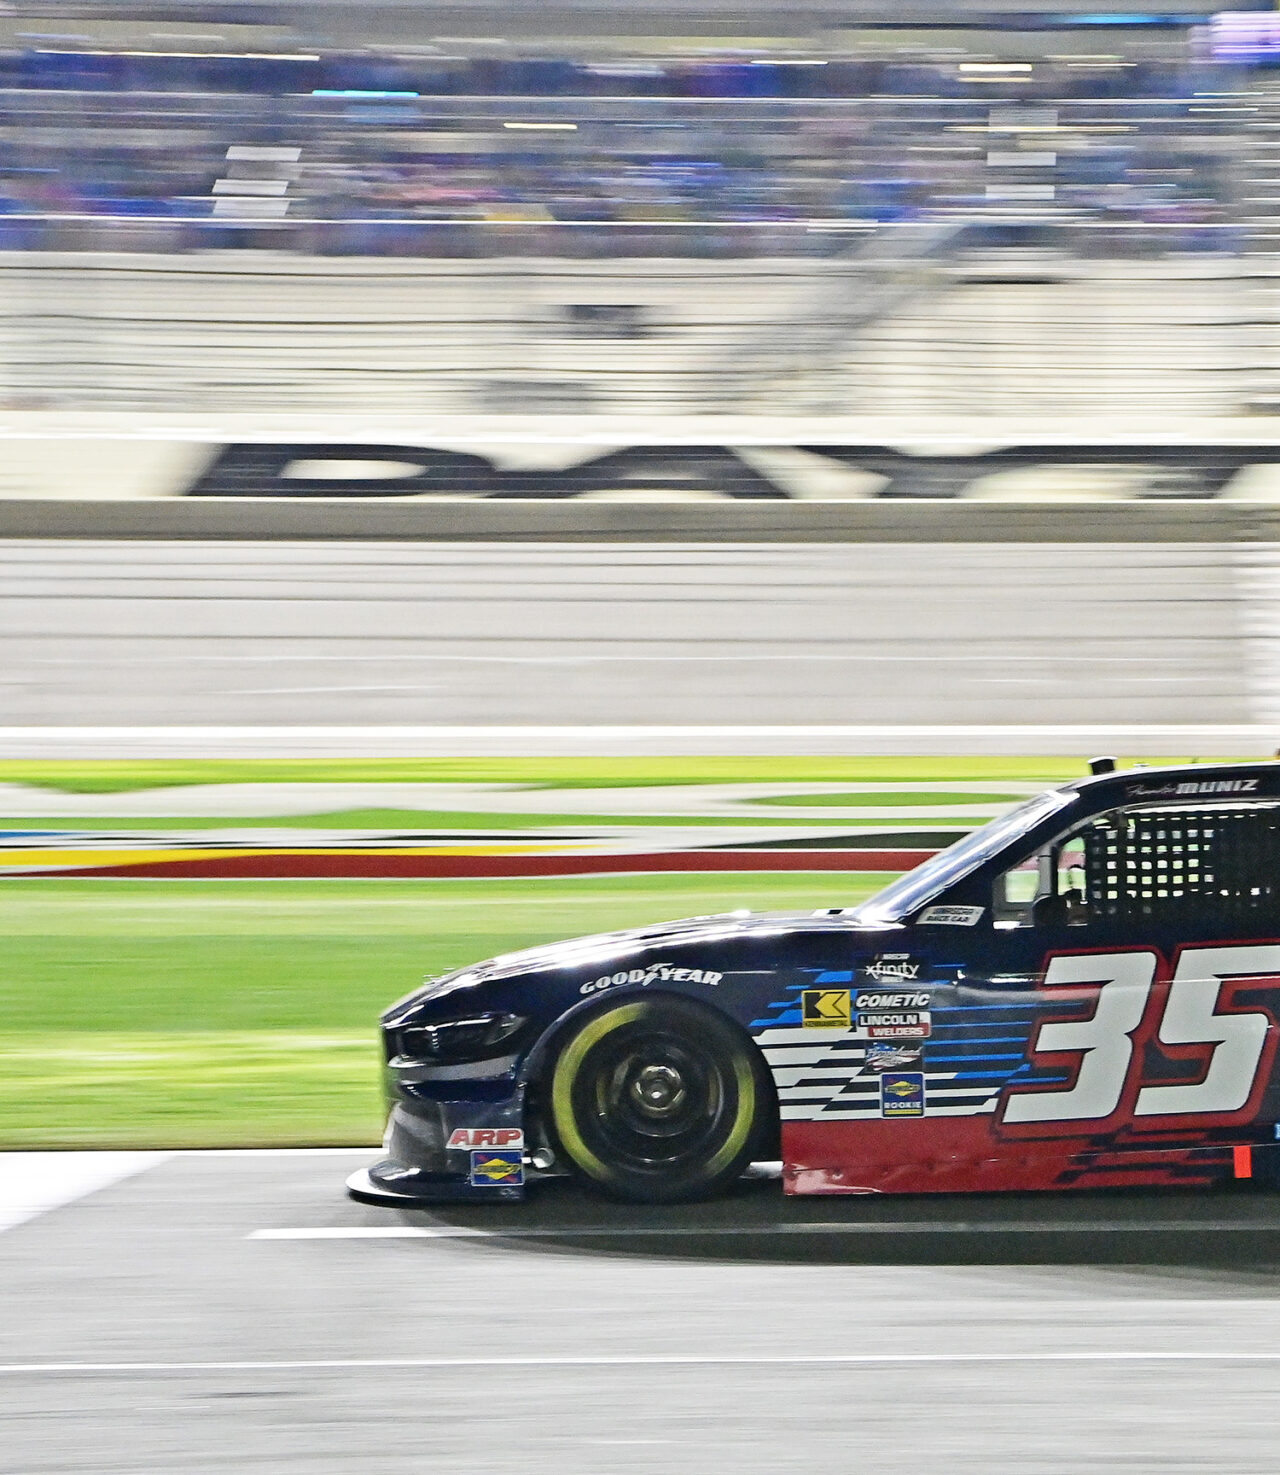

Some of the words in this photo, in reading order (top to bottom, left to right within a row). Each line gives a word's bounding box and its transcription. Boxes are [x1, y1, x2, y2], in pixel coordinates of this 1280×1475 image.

[1176, 779, 1259, 794] MUNIZ
[865, 961, 920, 979] xfinity
[579, 962, 724, 995] GOODYEAR
[855, 991, 931, 1009] COMETIC
[860, 1014, 918, 1026] LINCOLN
[872, 1027, 925, 1037] WELDERS
[883, 1101, 922, 1109] ROOKIE
[450, 1129, 522, 1146] ARP
